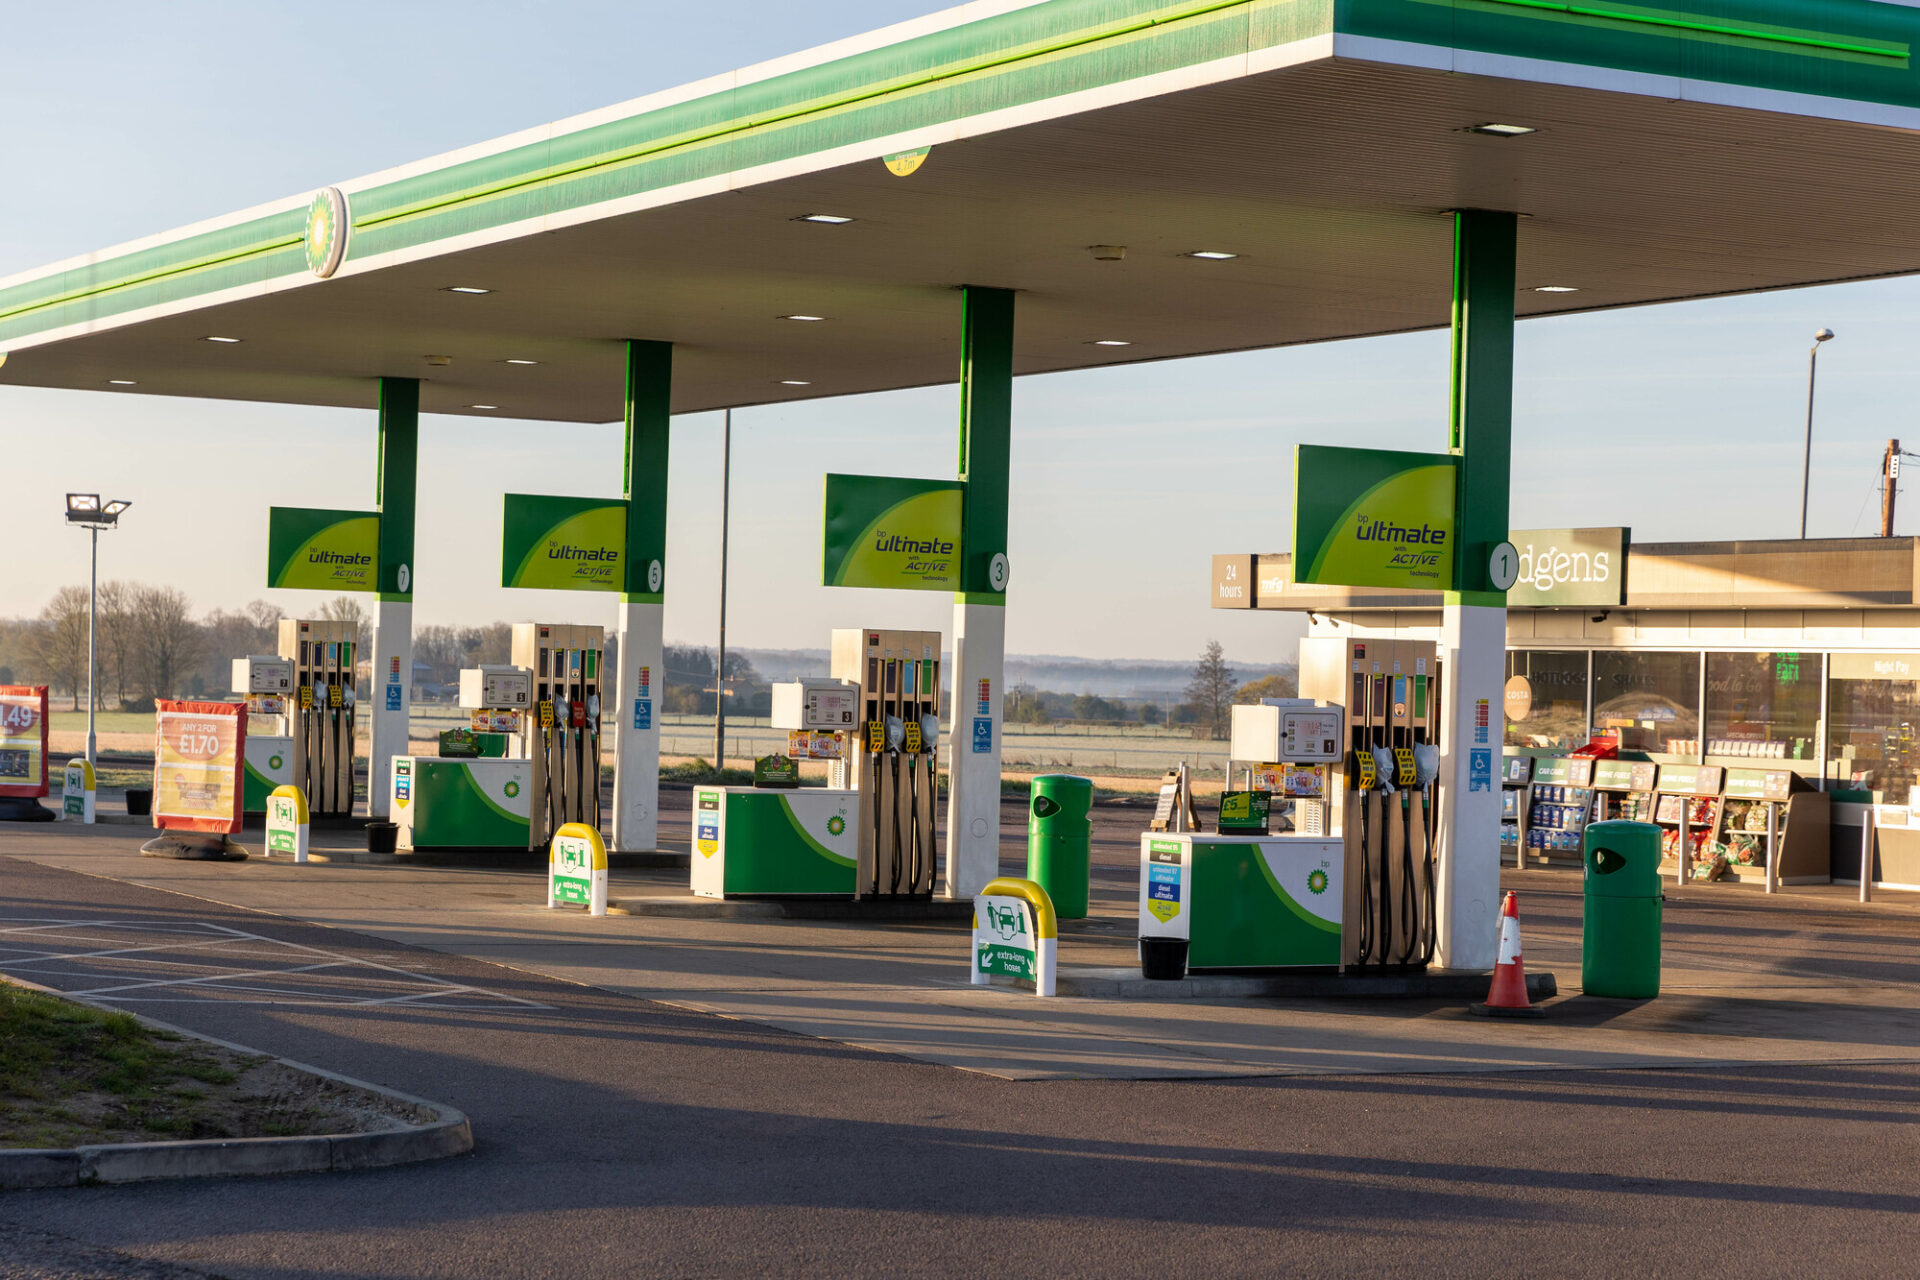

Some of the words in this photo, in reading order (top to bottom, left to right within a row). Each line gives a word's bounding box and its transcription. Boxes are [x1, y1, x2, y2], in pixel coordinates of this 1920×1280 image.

[1357, 512, 1368, 524] bp
[876, 529, 886, 538] bp
[1356, 520, 1446, 544] ultimate
[876, 535, 954, 554] ultimate
[308, 551, 372, 566] ultimate
[548, 545, 618, 562] ultimate
[1390, 554, 1440, 566] ACTIVE
[905, 562, 948, 572] ACTIVE
[996, 562, 1003, 582] 3
[1226, 564, 1236, 580] 24
[1500, 554, 1508, 578] 1
[401, 571, 406, 585] 7
[652, 568, 658, 584] 5
[1410, 570, 1440, 578] technology
[1220, 583, 1242, 598] hours
[1261, 577, 1284, 593] mfg
[1874, 660, 1894, 674] Night
[1896, 660, 1910, 675] Pay
[1506, 690, 1528, 700] COSTA
[180, 734, 219, 755] £1.70
[1321, 860, 1330, 868] bp
[996, 950, 1025, 965] extra-long
[1004, 962, 1022, 973] hoses
